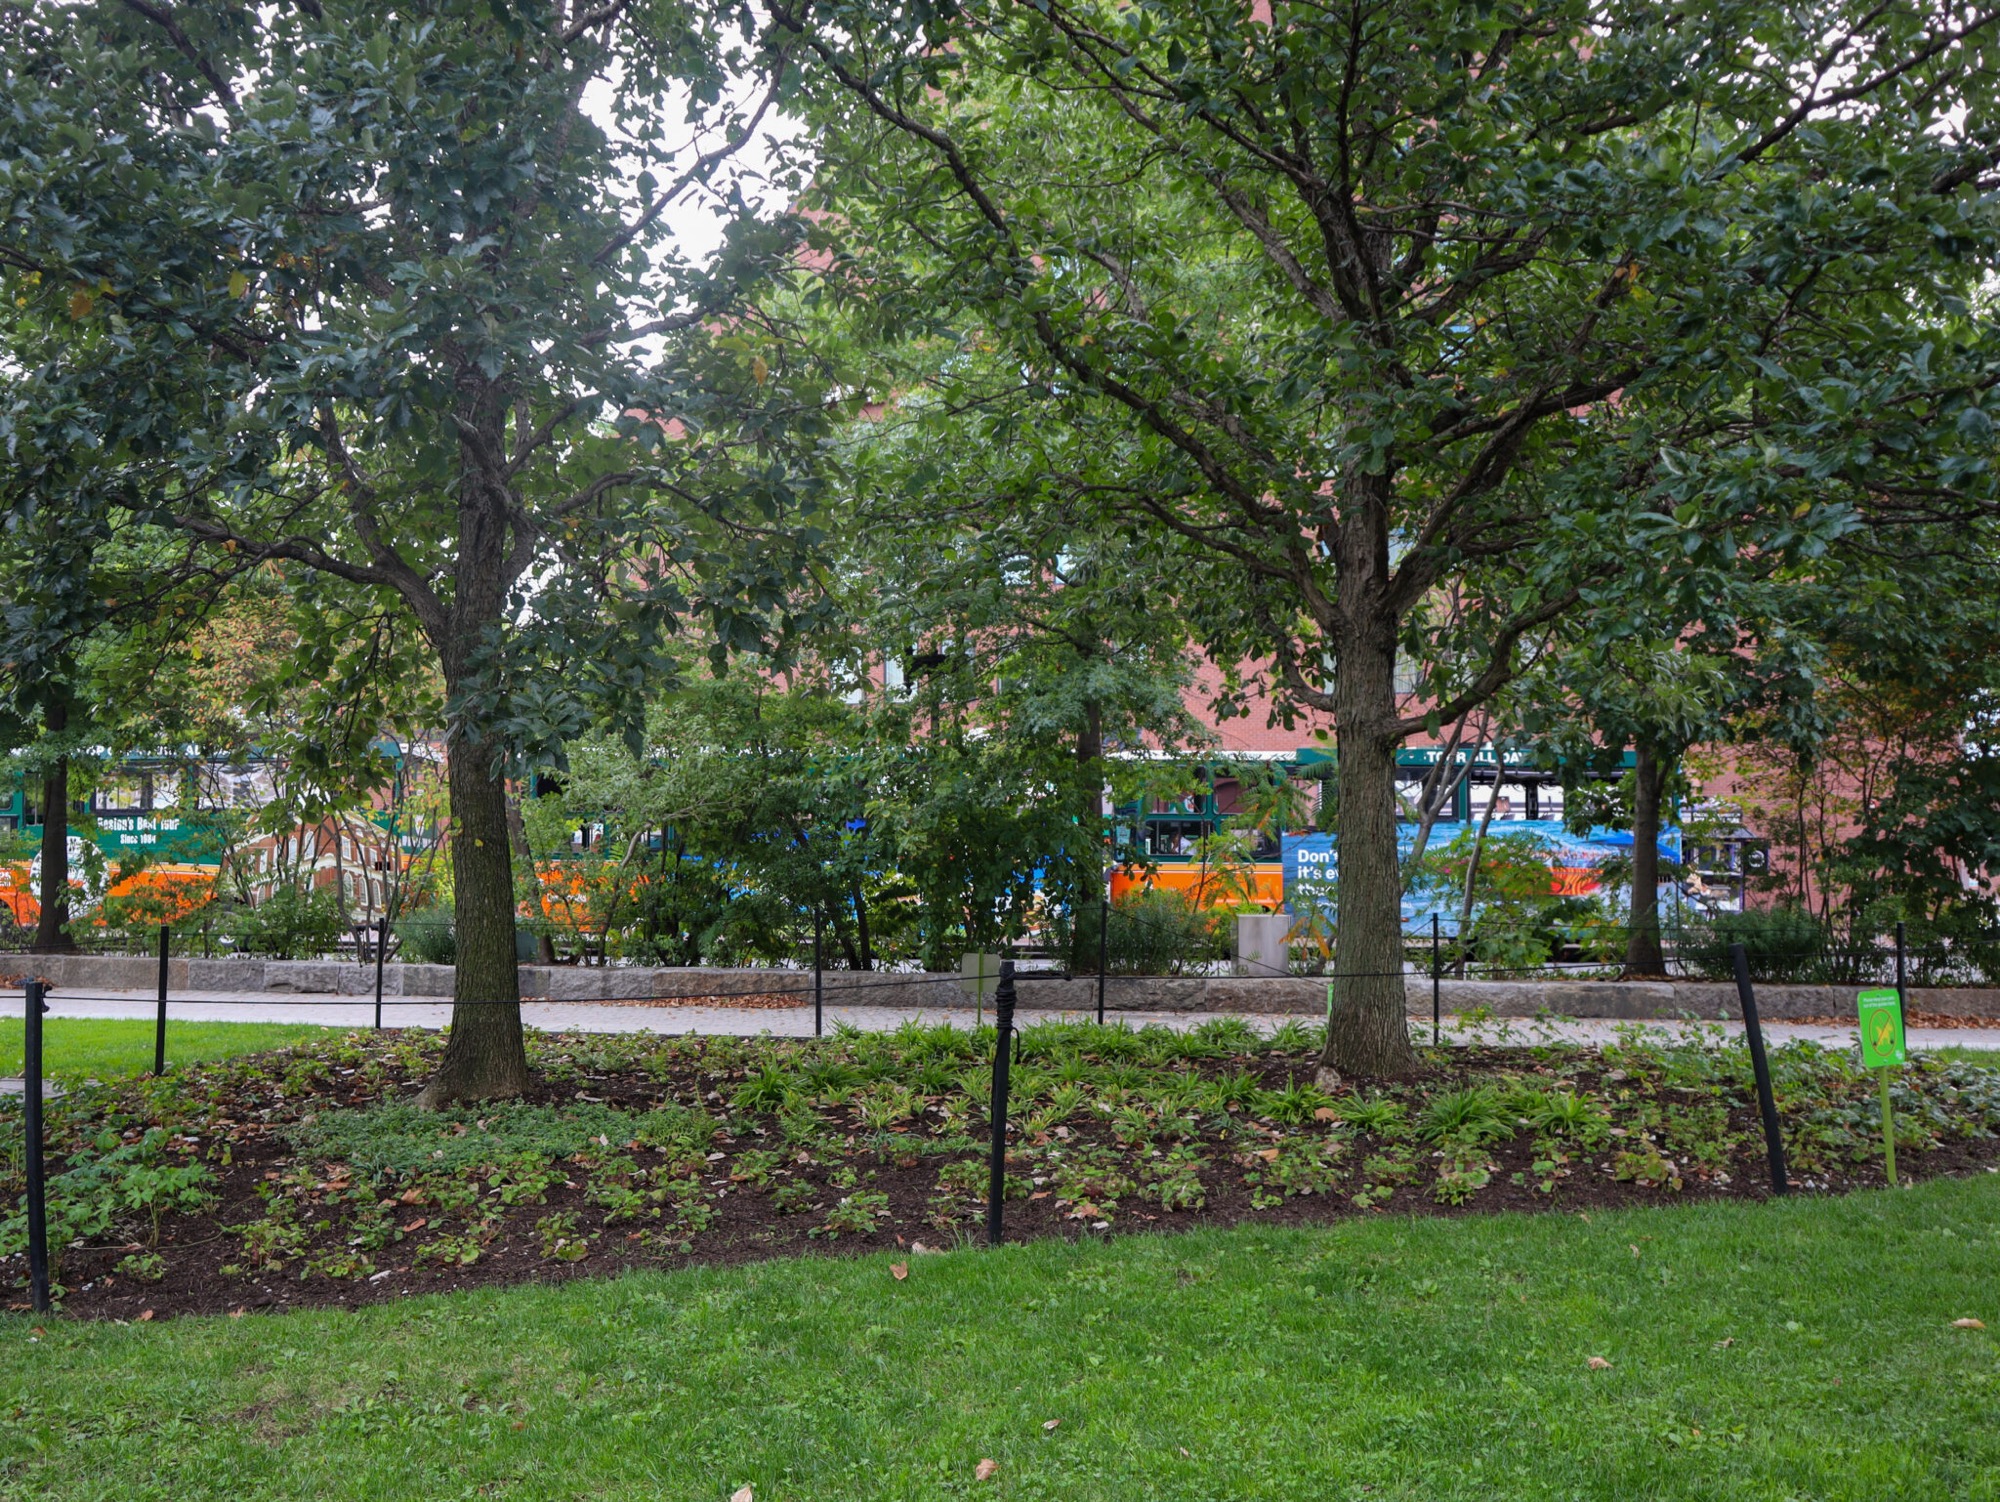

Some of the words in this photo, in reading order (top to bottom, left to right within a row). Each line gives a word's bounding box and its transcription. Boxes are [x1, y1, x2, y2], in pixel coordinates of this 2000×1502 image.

[120, 834, 138, 844] Since
[1298, 849, 1339, 863] Don't
[1298, 866, 1322, 880] it's
